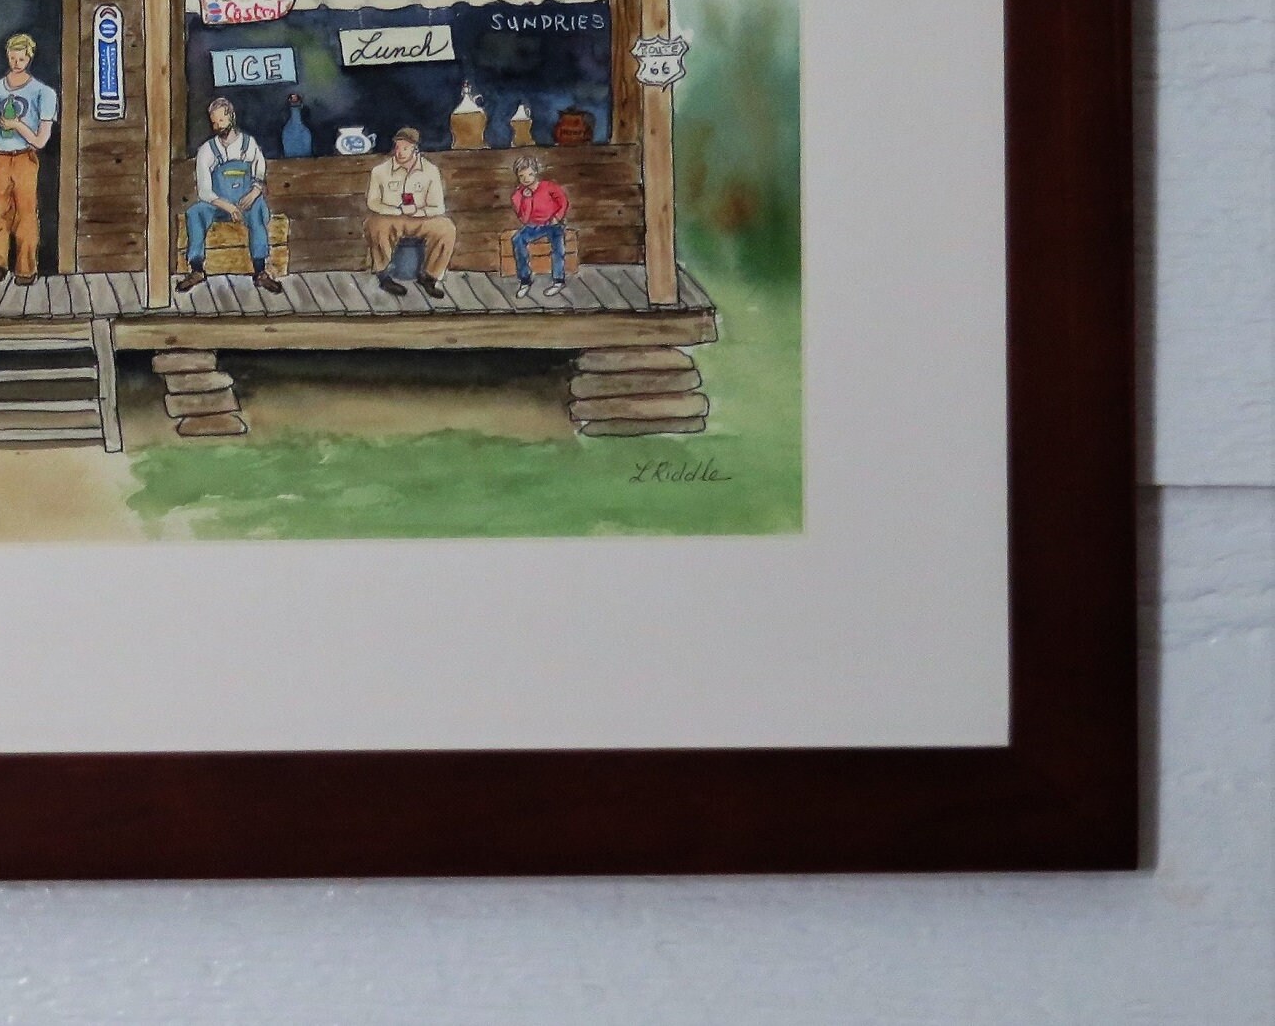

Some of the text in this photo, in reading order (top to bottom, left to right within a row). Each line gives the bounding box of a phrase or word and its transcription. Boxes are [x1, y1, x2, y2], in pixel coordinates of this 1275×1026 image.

[225, 0, 284, 23] Castrol
[491, 13, 605, 32] SUNDRIES
[350, 30, 449, 64] Lunch
[226, 54, 282, 83] ICE
[650, 61, 670, 75] 66
